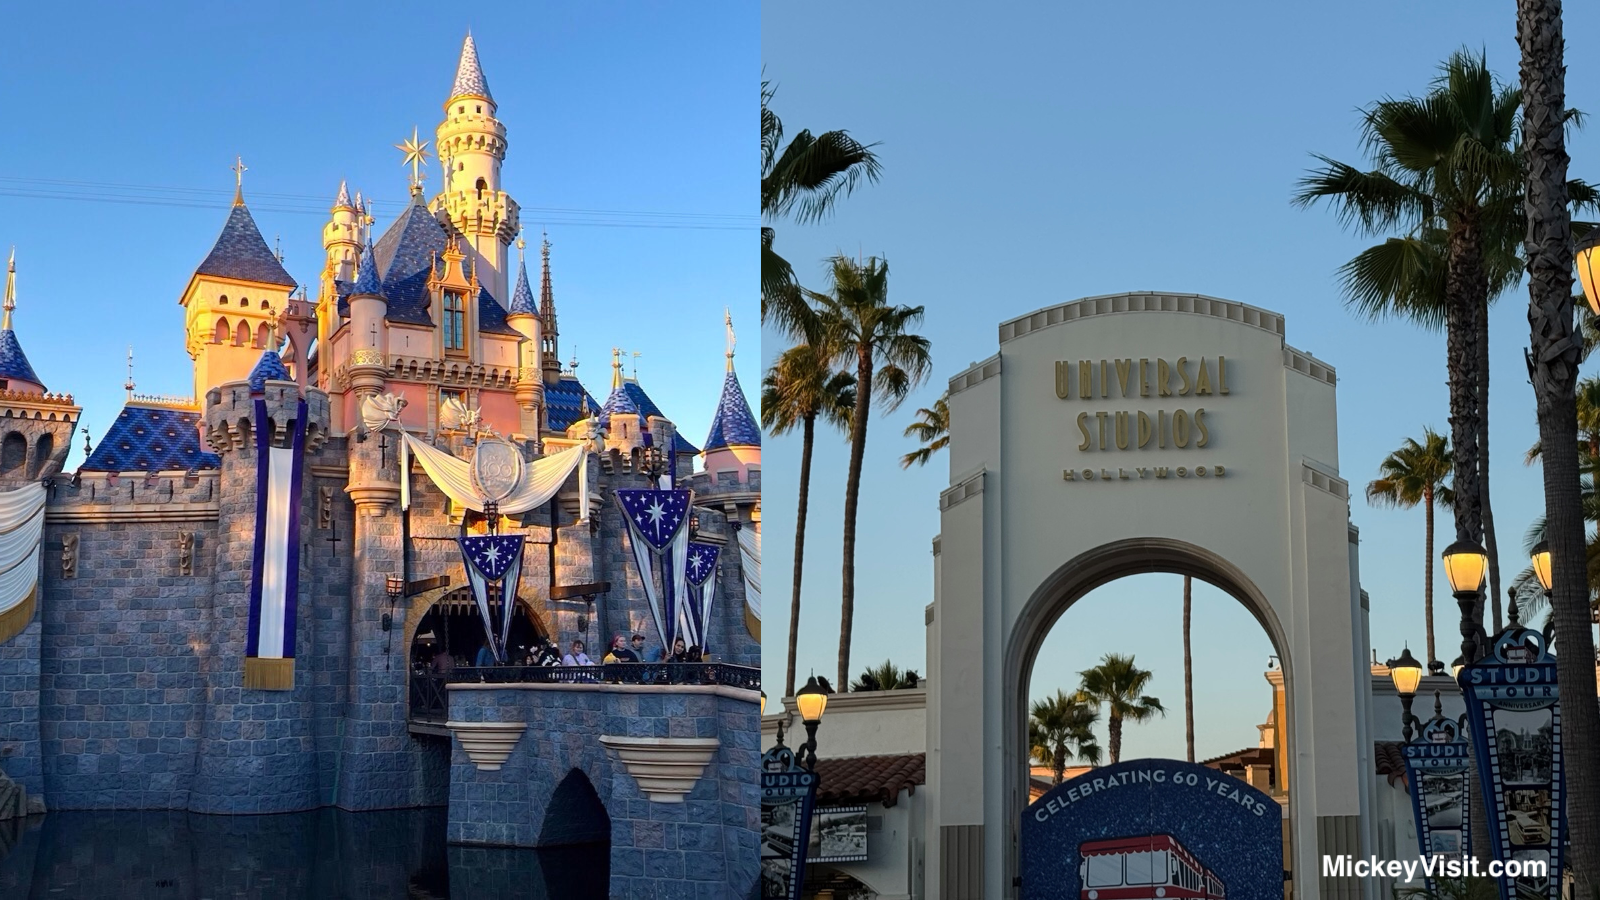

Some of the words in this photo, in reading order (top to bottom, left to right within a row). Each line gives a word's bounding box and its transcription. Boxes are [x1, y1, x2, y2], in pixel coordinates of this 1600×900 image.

[1055, 355, 1230, 400] UNIVERSAL
[1076, 408, 1209, 451] STUDIOS
[1062, 465, 1226, 481] HOLLYWOOD
[1470, 667, 1551, 684] STUDI
[1490, 686, 1552, 698] TOUR
[1498, 699, 1545, 709] ANNIVERSARY
[1406, 745, 1469, 758] STUDI
[1420, 758, 1463, 767] TOUR
[764, 773, 812, 787] UDIO
[765, 787, 797, 796] OUR
[1034, 769, 1166, 823] CELEBRATING
[1172, 771, 1198, 787] 60
[1205, 777, 1267, 817] YEARS
